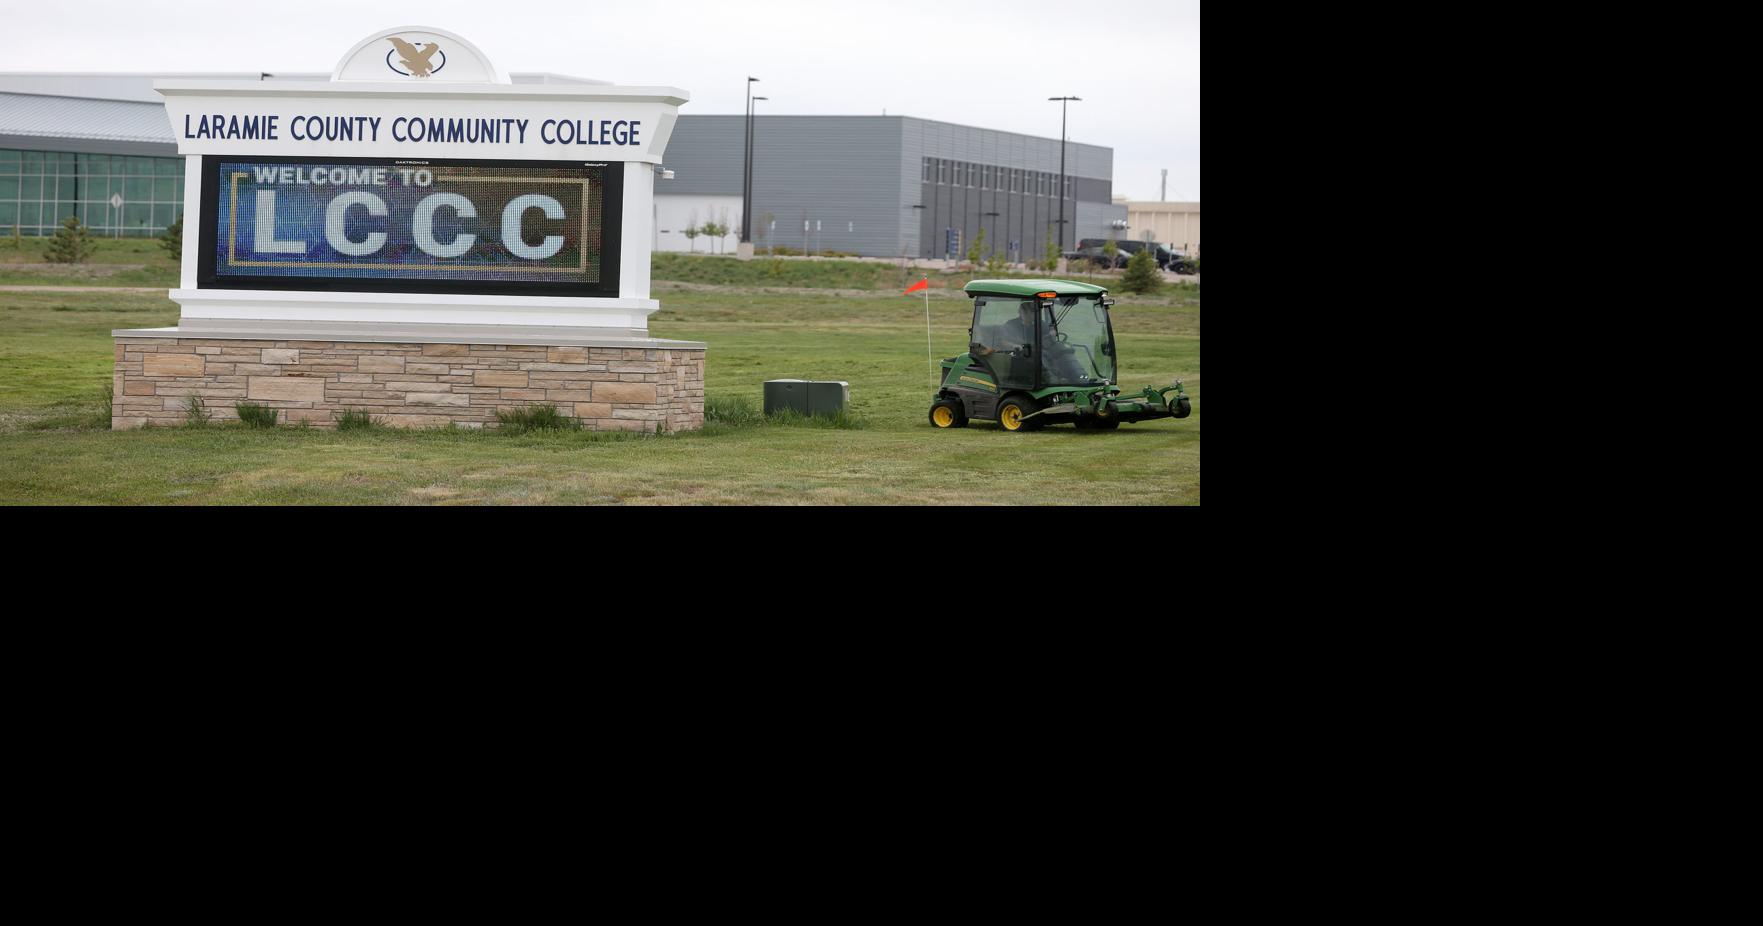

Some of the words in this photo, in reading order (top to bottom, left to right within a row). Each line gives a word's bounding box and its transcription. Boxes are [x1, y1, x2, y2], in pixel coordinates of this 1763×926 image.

[184, 114, 279, 140] LARAMIE
[291, 115, 382, 142] COUNTY
[391, 116, 529, 144] COMMUNITY
[540, 119, 641, 146] COLLEGE
[254, 166, 387, 186] WELCOME
[400, 168, 433, 187] TO
[254, 189, 566, 260] LCCC
